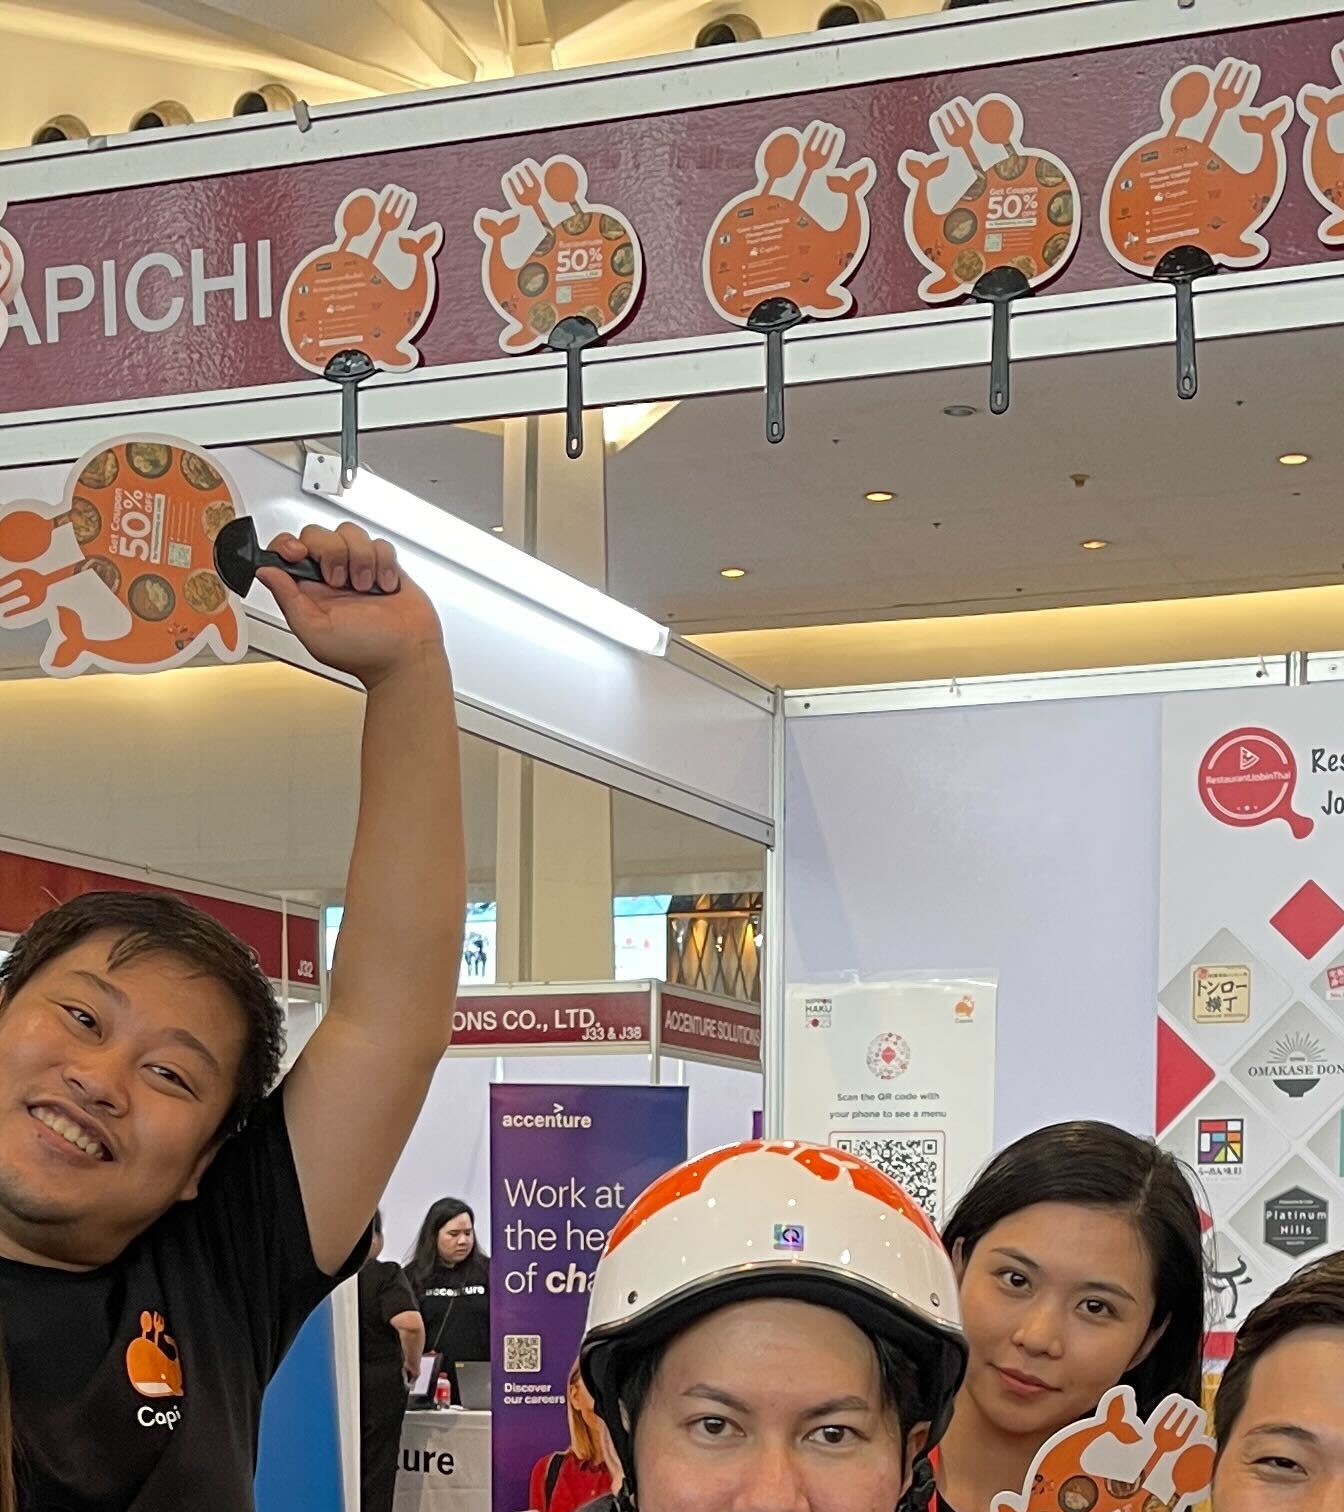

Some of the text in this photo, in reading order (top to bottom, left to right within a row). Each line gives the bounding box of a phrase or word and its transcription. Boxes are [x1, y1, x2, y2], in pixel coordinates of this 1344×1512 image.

[987, 194, 1038, 219] 50%
[557, 247, 603, 272] 50%
[2, 239, 273, 346] APICHI
[119, 490, 151, 560] 50%
[1197, 980, 1247, 996] トンロー
[503, 1010, 548, 1031] CO.,
[555, 1009, 601, 1029] LTD.
[664, 1010, 760, 1046] ACCENTURE SOLUTIONS
[582, 1027, 642, 1040] J33 & J38
[1248, 1065, 1312, 1077] OMAKASE
[837, 1092, 940, 1101] Scan the QR code with
[502, 1103, 591, 1129] accenture
[830, 1110, 849, 1119] your
[852, 1110, 880, 1119] phone
[883, 1110, 892, 1118] to
[505, 1177, 625, 1208] Work at
[1266, 1210, 1326, 1220] Platinum
[504, 1219, 612, 1251] the he
[505, 1262, 538, 1293] of
[504, 1382, 551, 1393] Discover
[504, 1394, 565, 1404] our careers
